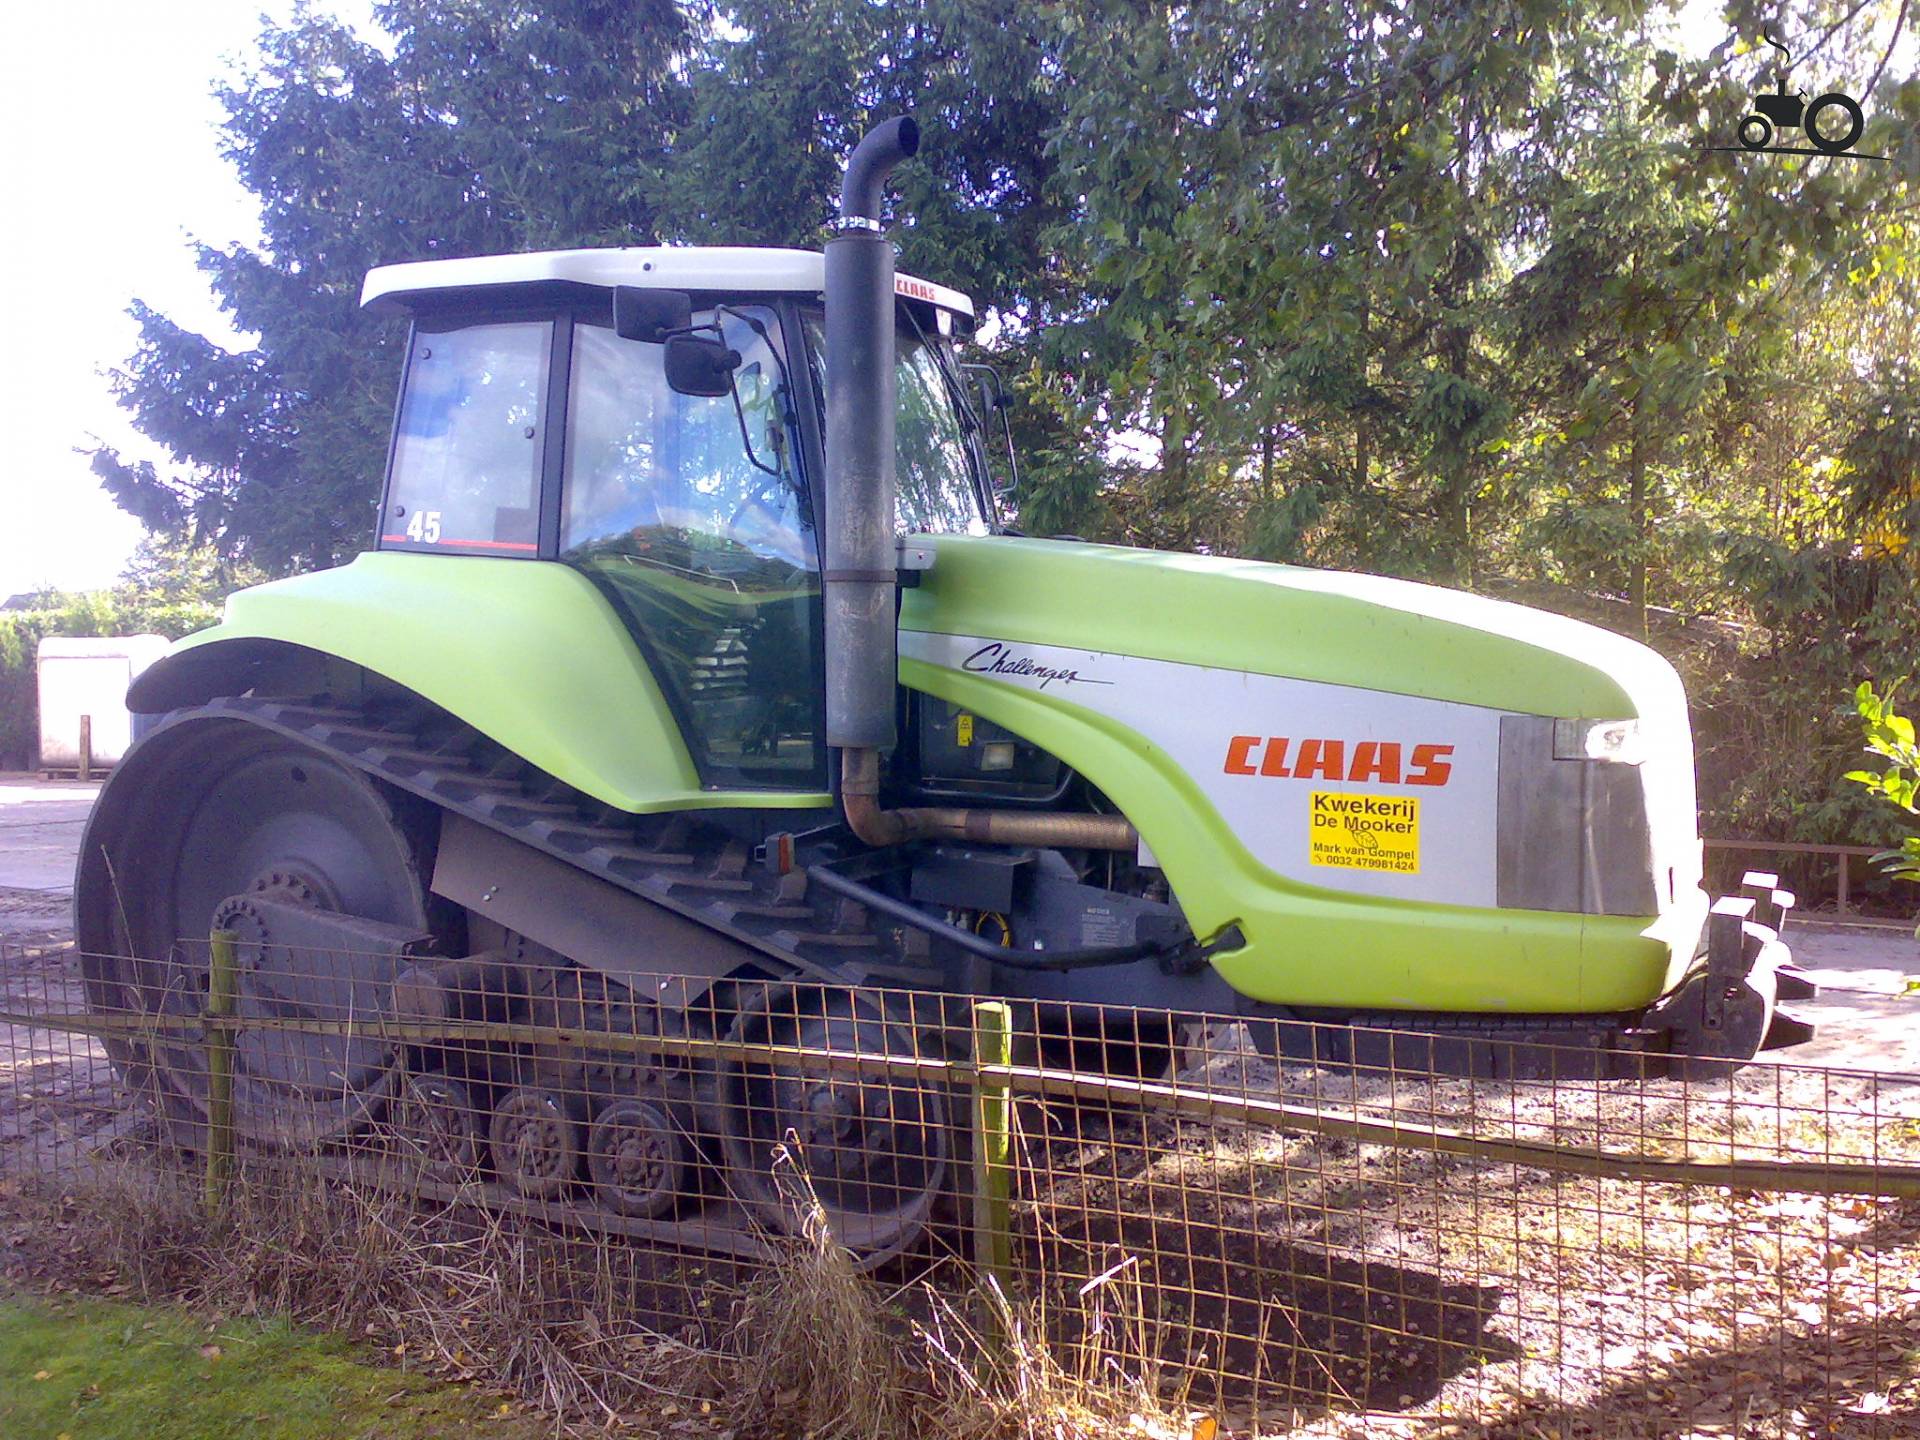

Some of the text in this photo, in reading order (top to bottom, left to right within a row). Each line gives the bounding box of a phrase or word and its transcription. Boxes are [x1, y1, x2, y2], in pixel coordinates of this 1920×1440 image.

[896, 279, 935, 301] CLAAS
[406, 510, 442, 544] 45
[962, 643, 1114, 689] Challenger
[1224, 736, 1455, 786] CLAAS
[1314, 794, 1415, 822] Kwekerij
[1314, 813, 1415, 834] De Mooker
[1313, 842, 1415, 860] Mark van Gompel
[1326, 855, 1352, 866] 0032
